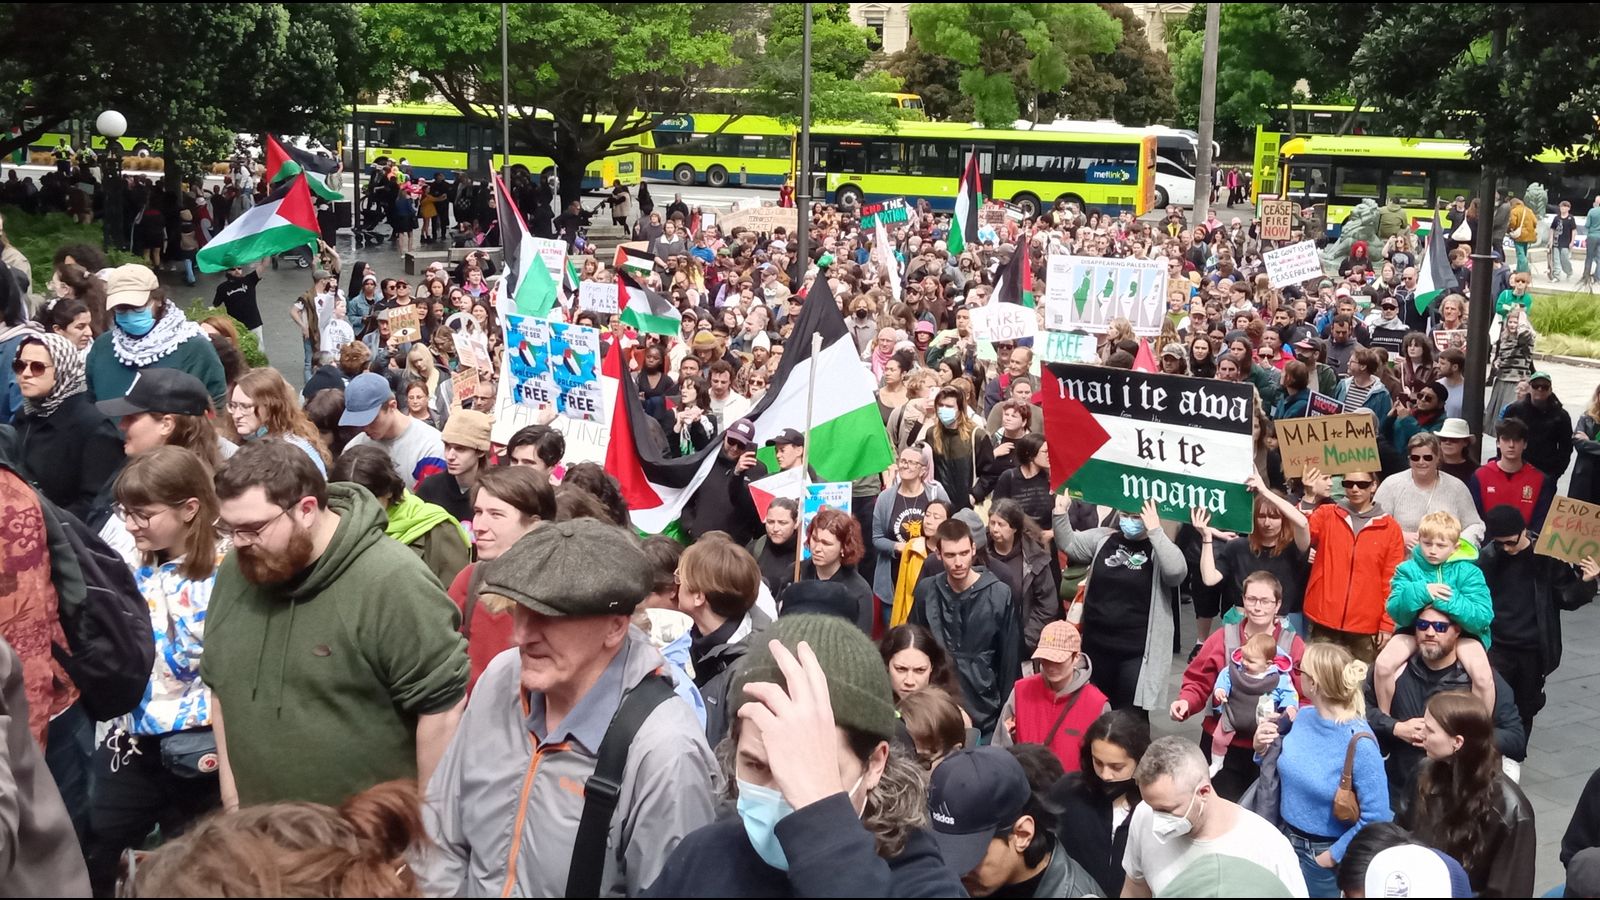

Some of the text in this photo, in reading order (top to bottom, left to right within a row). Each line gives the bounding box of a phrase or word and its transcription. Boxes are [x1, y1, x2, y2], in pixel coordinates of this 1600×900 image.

[1093, 170, 1121, 179] metlink
[882, 197, 904, 211] THE
[1263, 204, 1291, 216] CEASE
[860, 207, 907, 230] OCCPATION
[1265, 216, 1289, 226] FIRE
[1264, 226, 1289, 237] NOW
[1081, 259, 1125, 267] DISAPPEARING
[985, 310, 1024, 327] FIRE
[990, 325, 1025, 341] NOW
[1046, 333, 1084, 359] FREE
[560, 392, 596, 412] FREE
[1057, 375, 1249, 424] mai i te awa
[1313, 399, 1338, 414] NOW
[1283, 421, 1329, 446] MAI
[1134, 427, 1207, 468] ki te
[1120, 473, 1228, 515] moana
[1556, 499, 1590, 517] END
[893, 508, 922, 535] WELLINGTON
[932, 811, 955, 825] adidas
